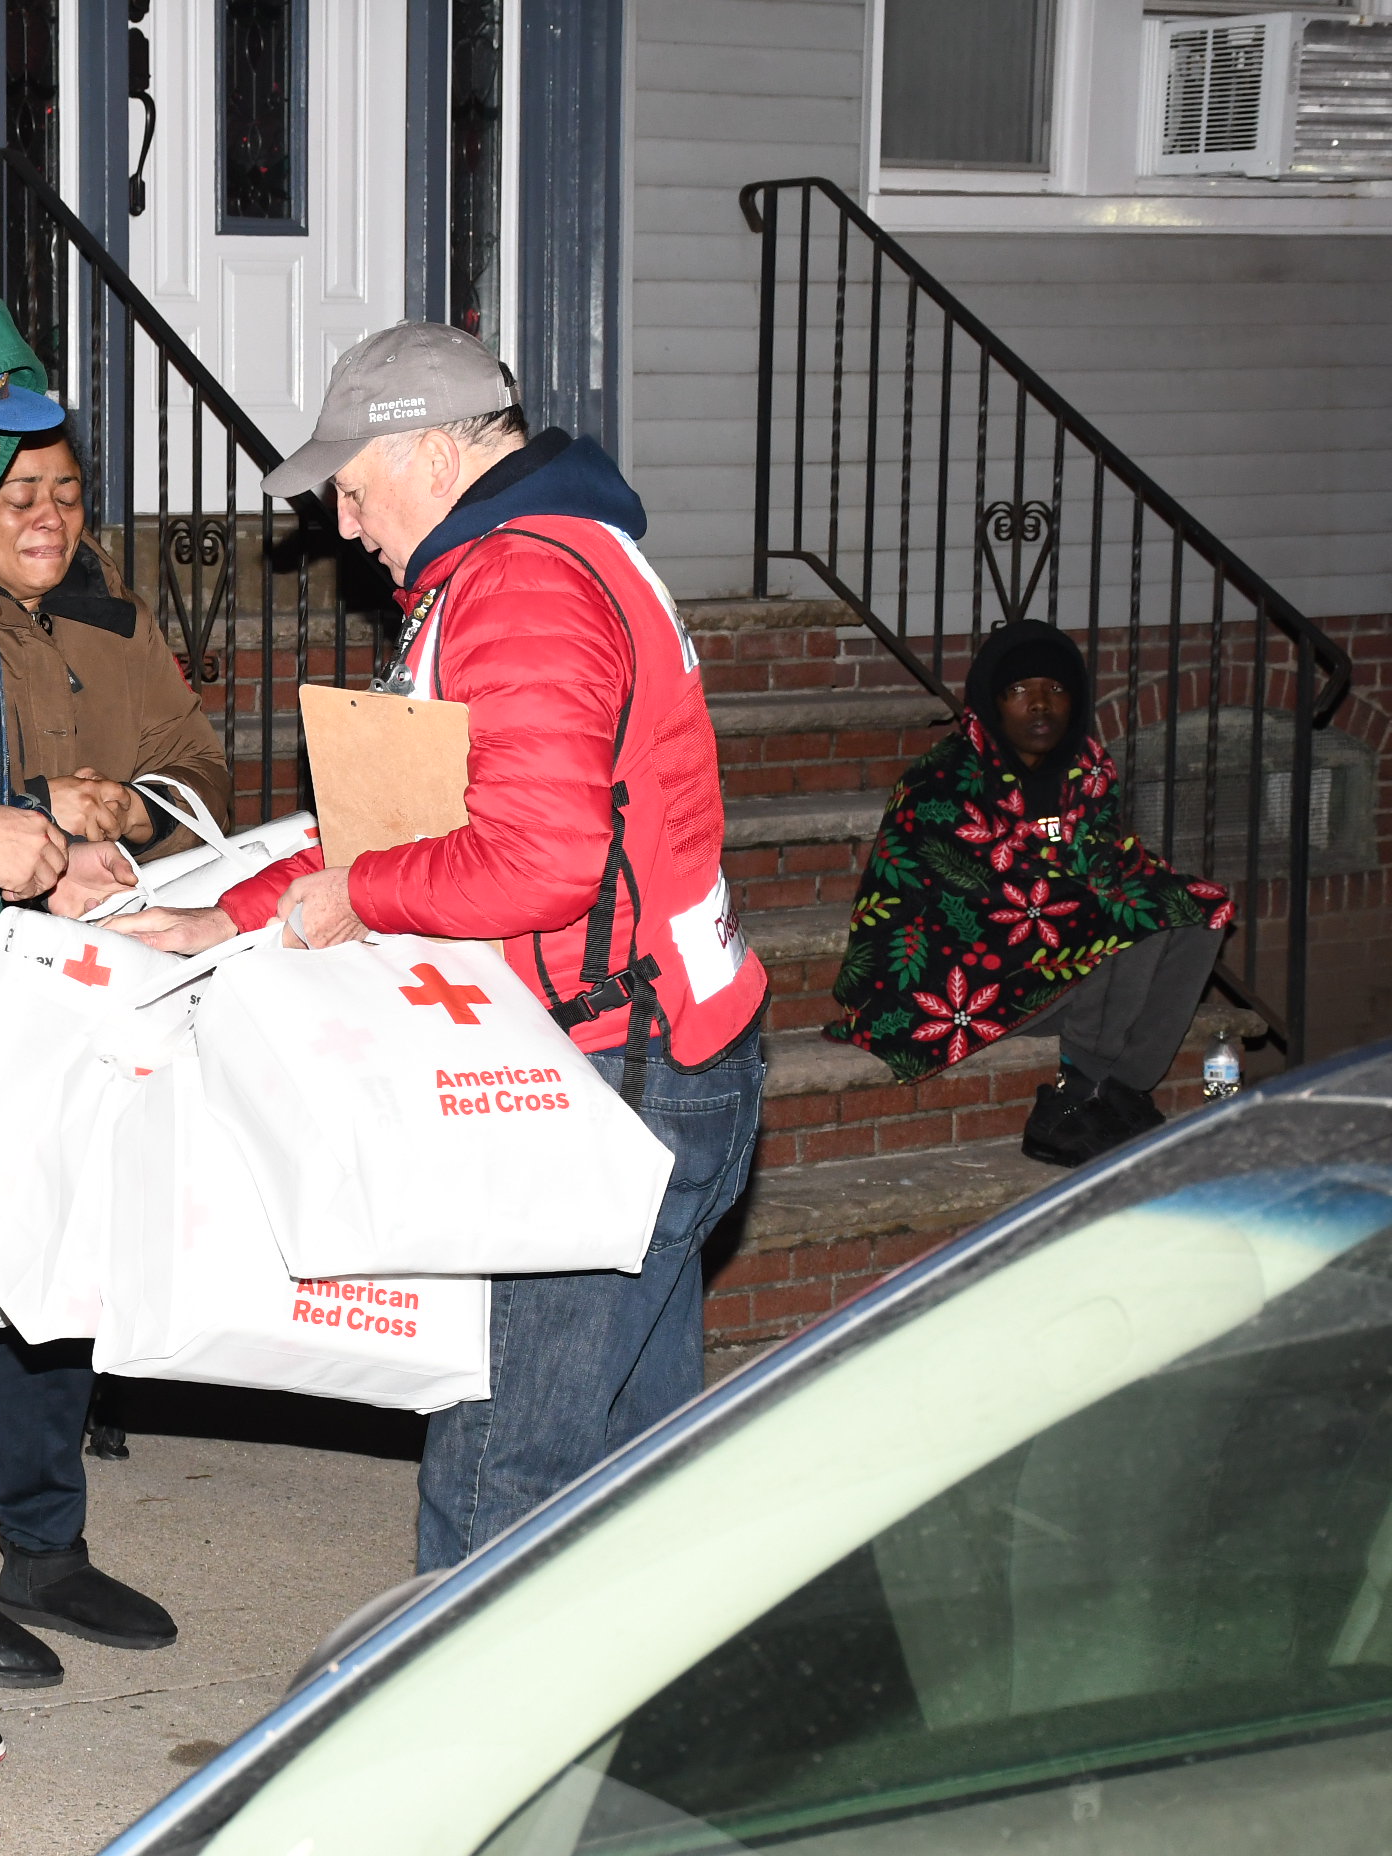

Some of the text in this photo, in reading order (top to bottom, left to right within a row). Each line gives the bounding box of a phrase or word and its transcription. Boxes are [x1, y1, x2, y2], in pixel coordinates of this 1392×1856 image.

[368, 408, 427, 423] Red Cross
[369, 397, 426, 413] American
[436, 1066, 562, 1089] American
[439, 1090, 570, 1117] Red Cross
[296, 1278, 419, 1311] American
[292, 1299, 417, 1338] Red Cross
